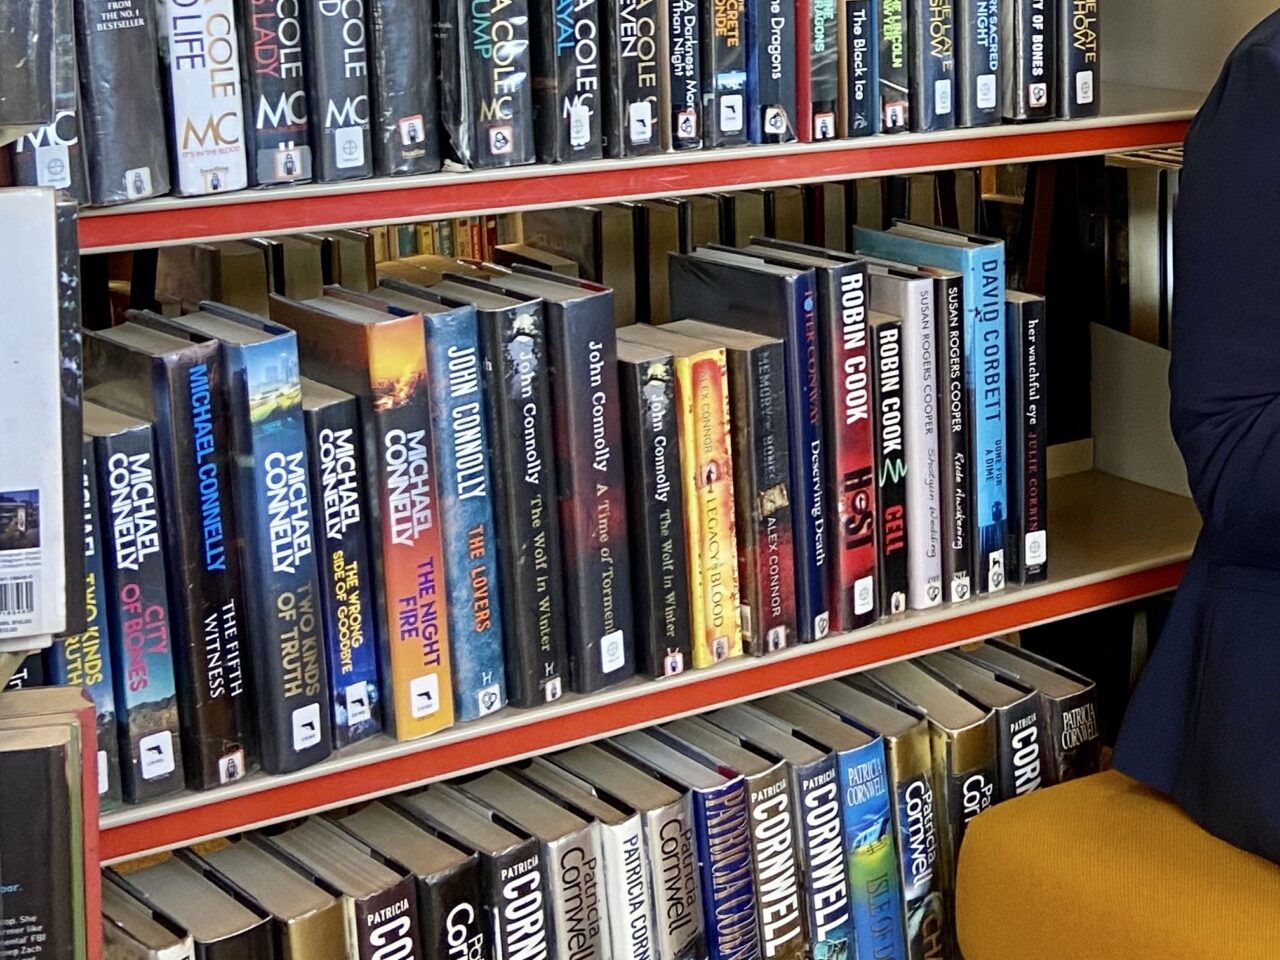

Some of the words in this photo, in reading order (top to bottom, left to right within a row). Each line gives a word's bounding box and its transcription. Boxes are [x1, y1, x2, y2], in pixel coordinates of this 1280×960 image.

[97, 18, 144, 31] BESTSELLER
[174, 12, 207, 71] LIFE
[251, 16, 281, 78] LADY
[770, 14, 785, 81] Dragons
[852, 9, 865, 35] The
[975, 0, 988, 47] NIGHT
[988, 15, 999, 71] SACRED
[1032, 13, 1043, 30] OF
[205, 19, 237, 100] COLE
[574, 18, 598, 93] COLE
[853, 39, 866, 76] Black
[1032, 34, 1044, 76] BONES
[854, 80, 864, 101] Ice
[841, 272, 865, 352] ROBIN
[948, 286, 958, 325] SUSAN
[981, 259, 999, 323] DAVID
[949, 329, 960, 378] ROGERS
[1028, 319, 1038, 338] her
[447, 345, 476, 395] JOHN
[879, 328, 899, 393] ROBIN
[982, 328, 1002, 422] CORBETT
[1028, 341, 1038, 395] watchful
[844, 357, 869, 426] COOK
[951, 381, 962, 433] COOPER
[1028, 397, 1038, 427] eye
[451, 401, 487, 501] CONNOLLY
[882, 397, 902, 456] COOK
[108, 451, 140, 571] CONNELLY
[129, 452, 160, 563] MICHAEL
[705, 497, 720, 555] LEGACY
[883, 505, 904, 556] CELL
[333, 550, 344, 576] SIDE
[468, 524, 485, 559] THE
[120, 582, 141, 615] OF
[335, 578, 346, 597] OF
[346, 561, 358, 585] THE
[416, 557, 436, 599] THE
[472, 565, 492, 634] LOVERS
[711, 565, 725, 629] BLOOD
[144, 604, 168, 654] CITY
[222, 598, 238, 639] THE
[337, 600, 352, 674] GOODBYE
[347, 590, 364, 648] WRONG
[399, 594, 418, 642] FIRE
[420, 601, 440, 667] NIGHT
[124, 620, 149, 692] BONES
[204, 612, 226, 699] WITNESS
[226, 640, 243, 697] FIFTH
[751, 778, 787, 804] PATRICIA
[846, 775, 887, 807] CORNWELL
[847, 758, 883, 784] PATRICIA
[659, 818, 692, 937] Cornwell
[752, 793, 799, 959] CORNWELL
[367, 898, 409, 927] PATRICIA
